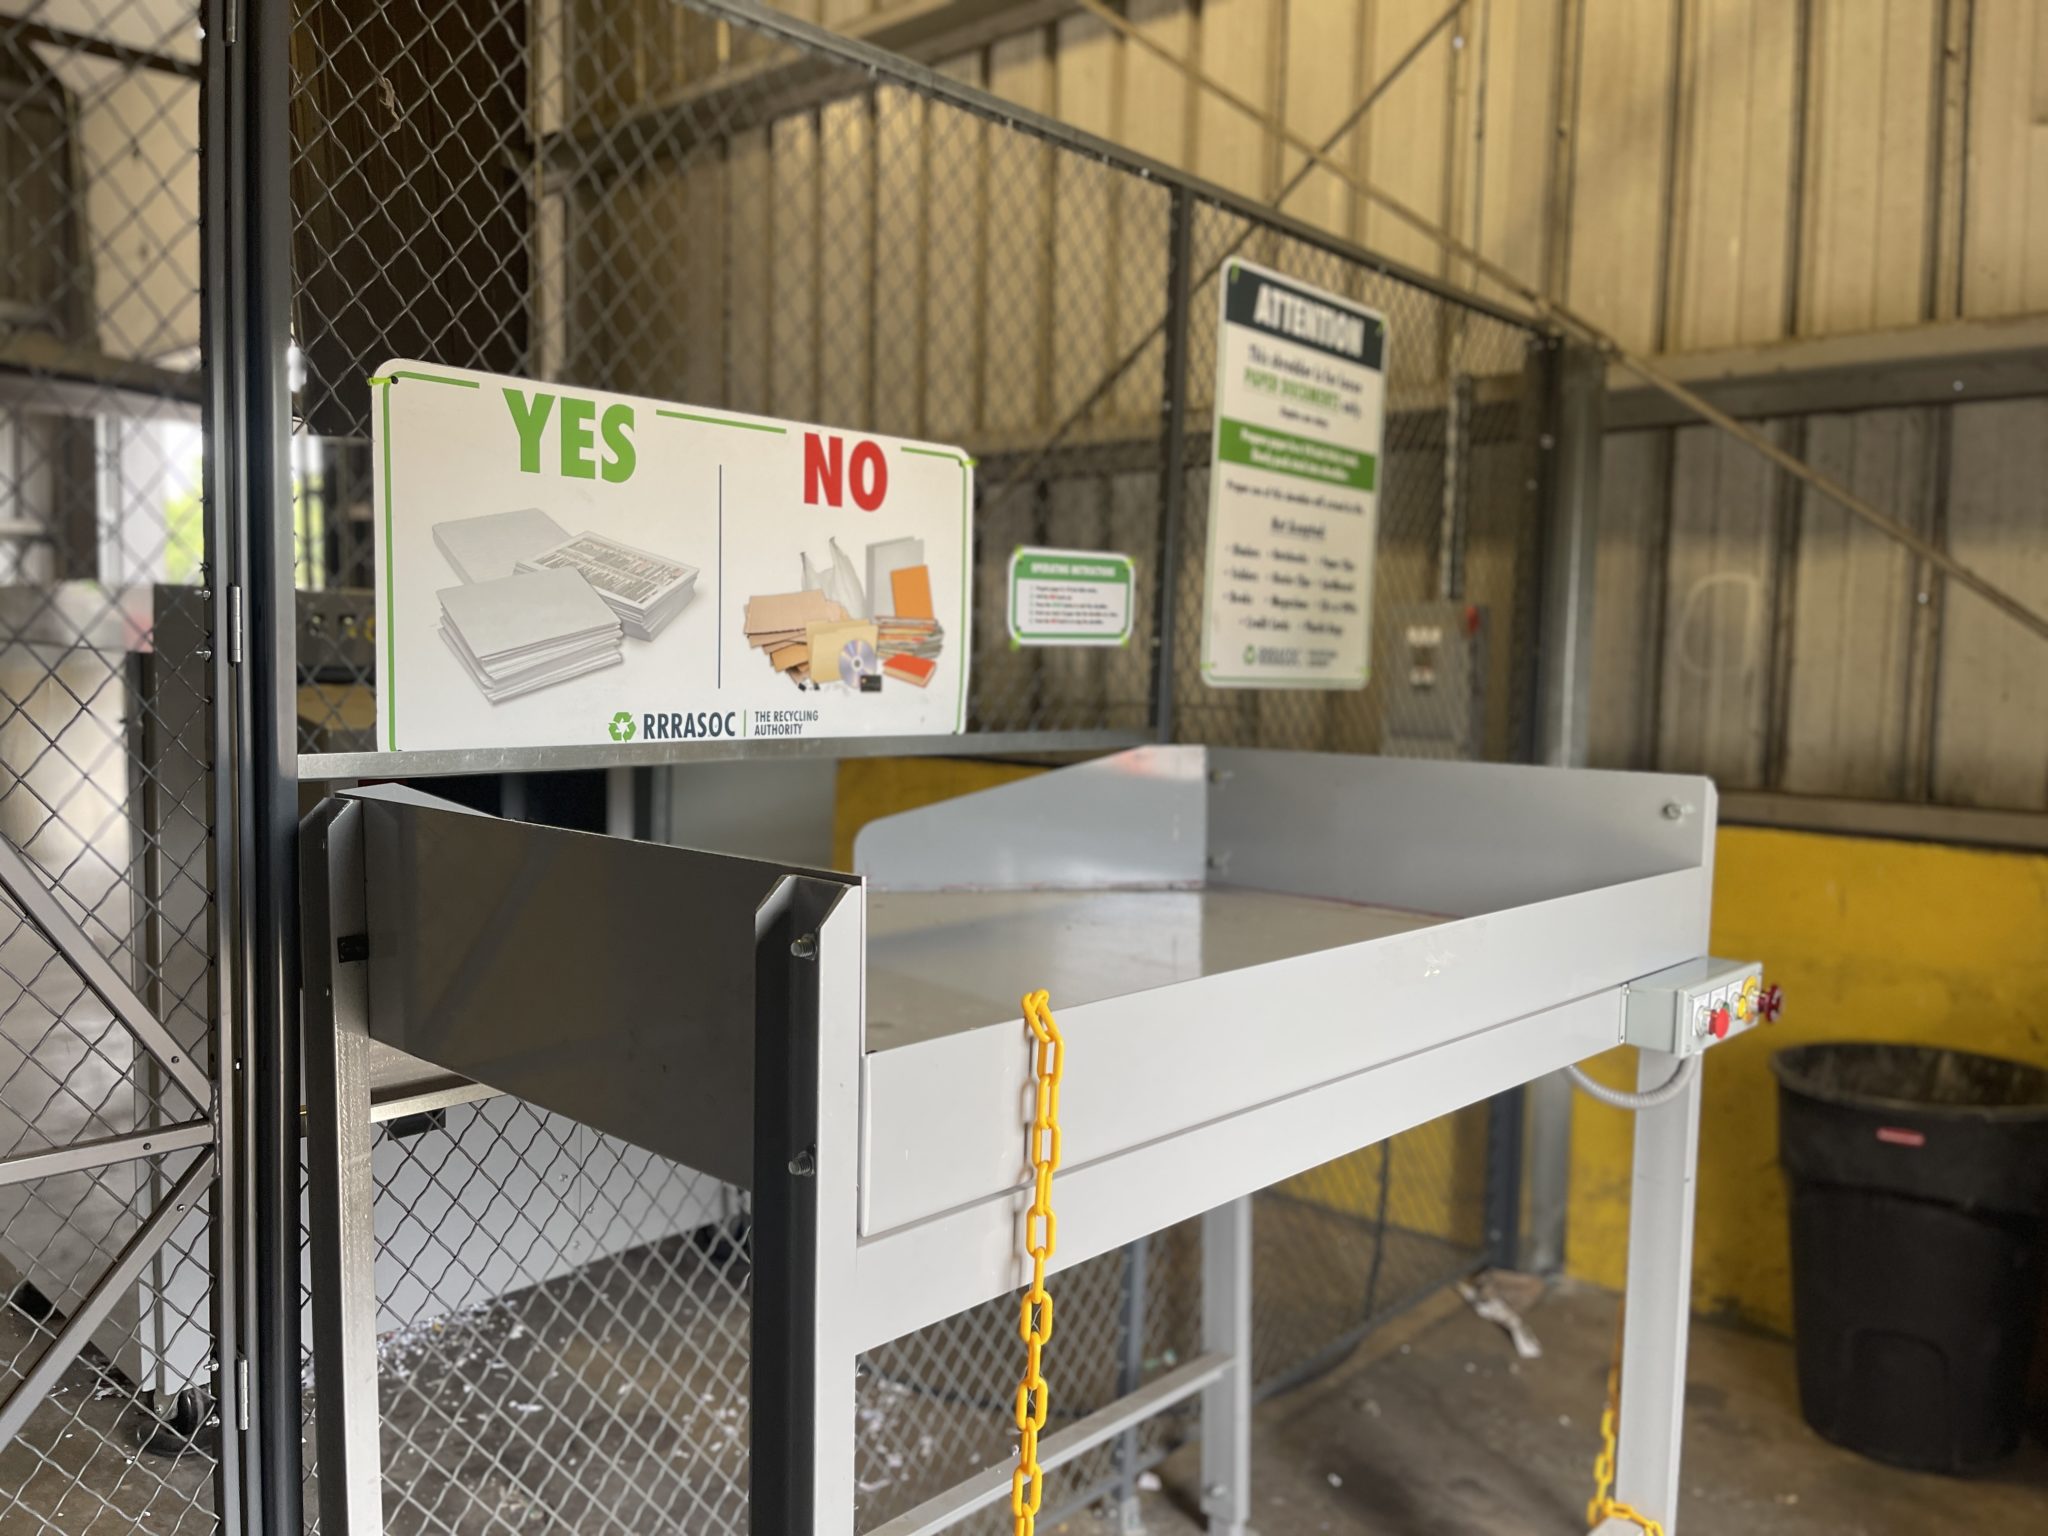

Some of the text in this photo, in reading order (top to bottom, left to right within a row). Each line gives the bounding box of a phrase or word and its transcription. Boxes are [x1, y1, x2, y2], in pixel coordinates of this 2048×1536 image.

[1254, 283, 1365, 358] ATTENTION
[502, 388, 637, 484] YES
[804, 433, 889, 512] NO
[643, 711, 736, 740] RRRASOC
[754, 710, 819, 723] THE RECYCLING
[754, 724, 803, 736] AUTHORITY
